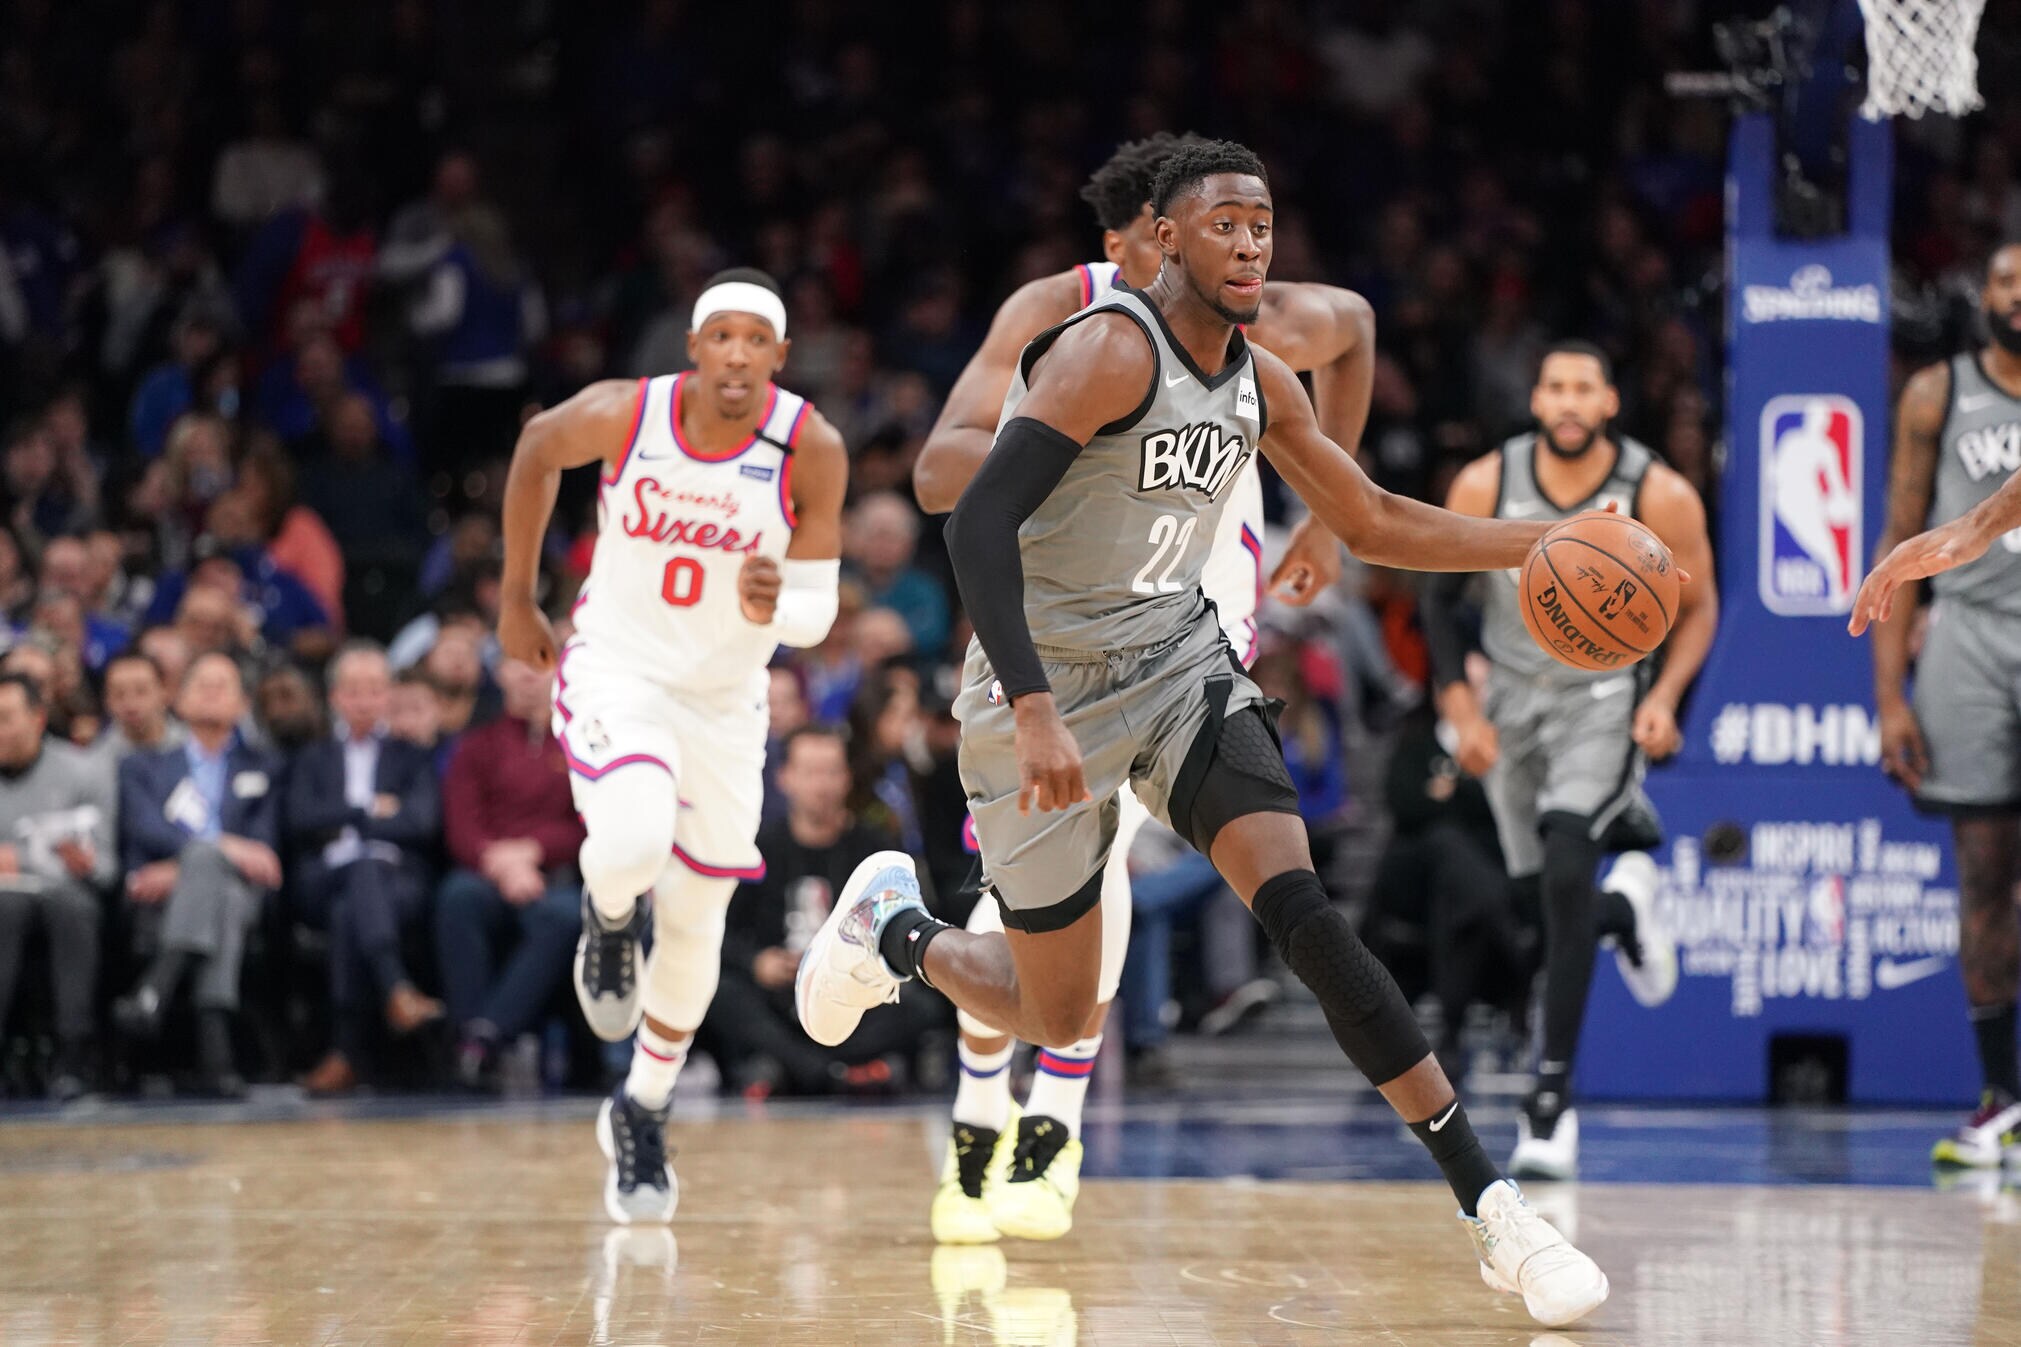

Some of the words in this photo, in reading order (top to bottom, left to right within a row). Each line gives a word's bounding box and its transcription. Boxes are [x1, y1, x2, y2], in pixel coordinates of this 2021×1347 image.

[1138, 422, 1251, 503] BKLYN
[661, 556, 705, 608] 0
[1132, 515, 1197, 593] 22
[1536, 585, 1628, 666] SPALDING
